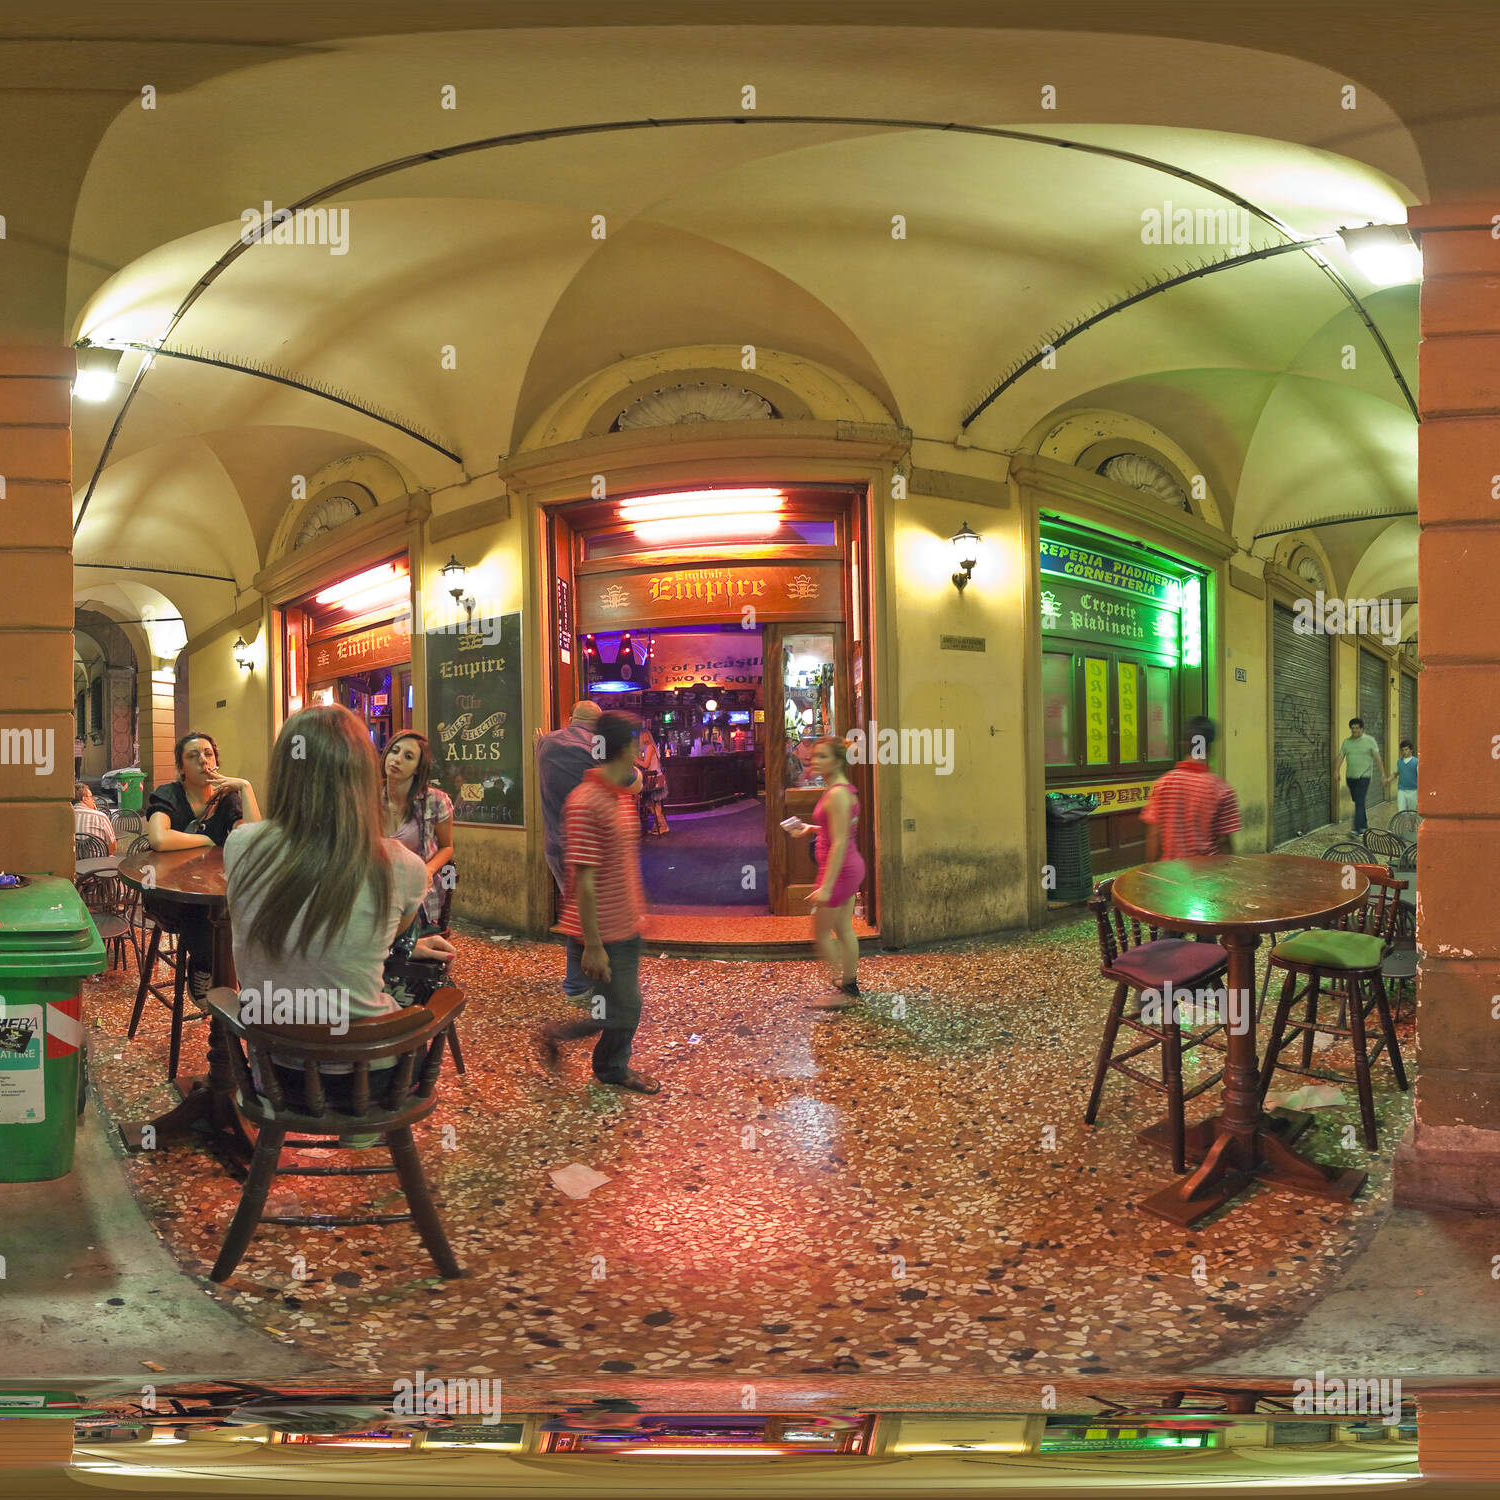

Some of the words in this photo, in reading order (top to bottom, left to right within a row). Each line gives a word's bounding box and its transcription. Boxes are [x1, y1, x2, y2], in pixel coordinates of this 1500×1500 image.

[1040, 542, 1103, 568] REPERIA
[649, 574, 767, 602] Empire
[1064, 562, 1155, 595] CORNETTERIA
[1080, 594, 1137, 620] Creperie
[1070, 610, 1144, 638] Piadineria
[337, 634, 391, 658] Empire
[439, 657, 506, 679] Empire
[442, 713, 471, 741] FINEST
[462, 712, 507, 740] SELECTION
[445, 742, 501, 761] ALES
